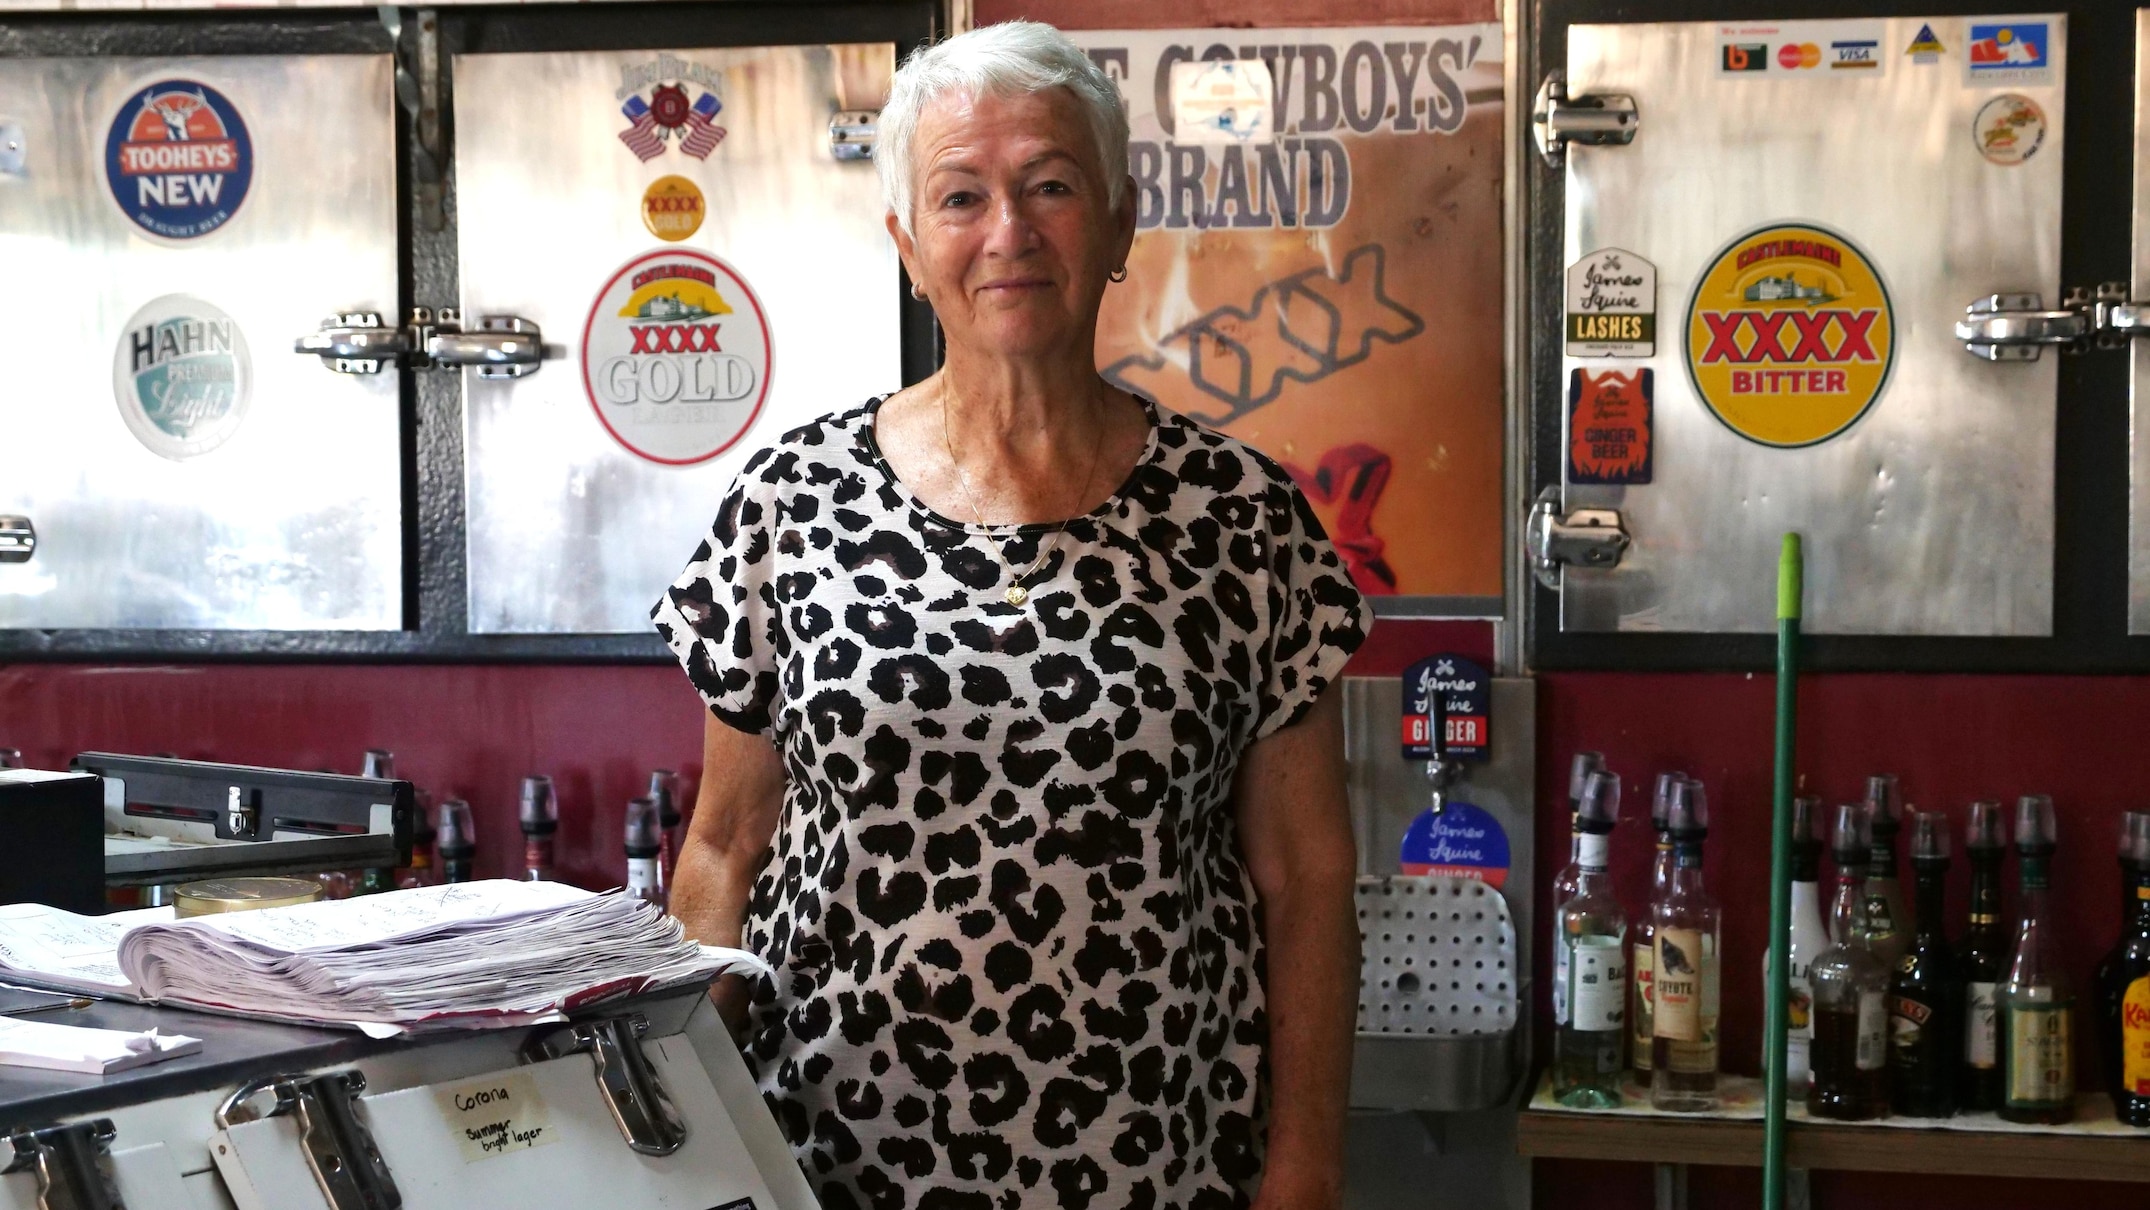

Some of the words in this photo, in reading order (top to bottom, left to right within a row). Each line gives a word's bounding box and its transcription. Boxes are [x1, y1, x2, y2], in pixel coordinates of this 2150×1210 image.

[1838, 48, 1870, 61] VISA
[1155, 36, 1482, 135] CWBOYS'
[124, 143, 232, 171] TOOHEYS
[137, 173, 224, 207] NEW
[1130, 138, 1352, 230] BRAND
[647, 196, 699, 213] XXXX
[653, 213, 693, 231] GOLD
[1736, 238, 1842, 271] CASTLEMAINE
[1583, 263, 1643, 289] James
[1580, 284, 1640, 311] Squire
[629, 323, 722, 355] XXXX
[1576, 315, 1642, 339] LASHES
[1700, 309, 1881, 364] XXXX
[131, 319, 232, 373] HAHN
[598, 353, 756, 406] GOLD
[1730, 369, 1850, 395] BITTER
[1584, 427, 1637, 443] GINGER
[1591, 444, 1628, 459] BEER
[1417, 665, 1477, 693] James
[1412, 718, 1477, 743] GIGER
[1429, 816, 1485, 839] James
[1428, 837, 1484, 862] Squire
[455, 1087, 510, 1112] Corona
[481, 1132, 509, 1153] bright
[511, 1127, 543, 1147] lager
